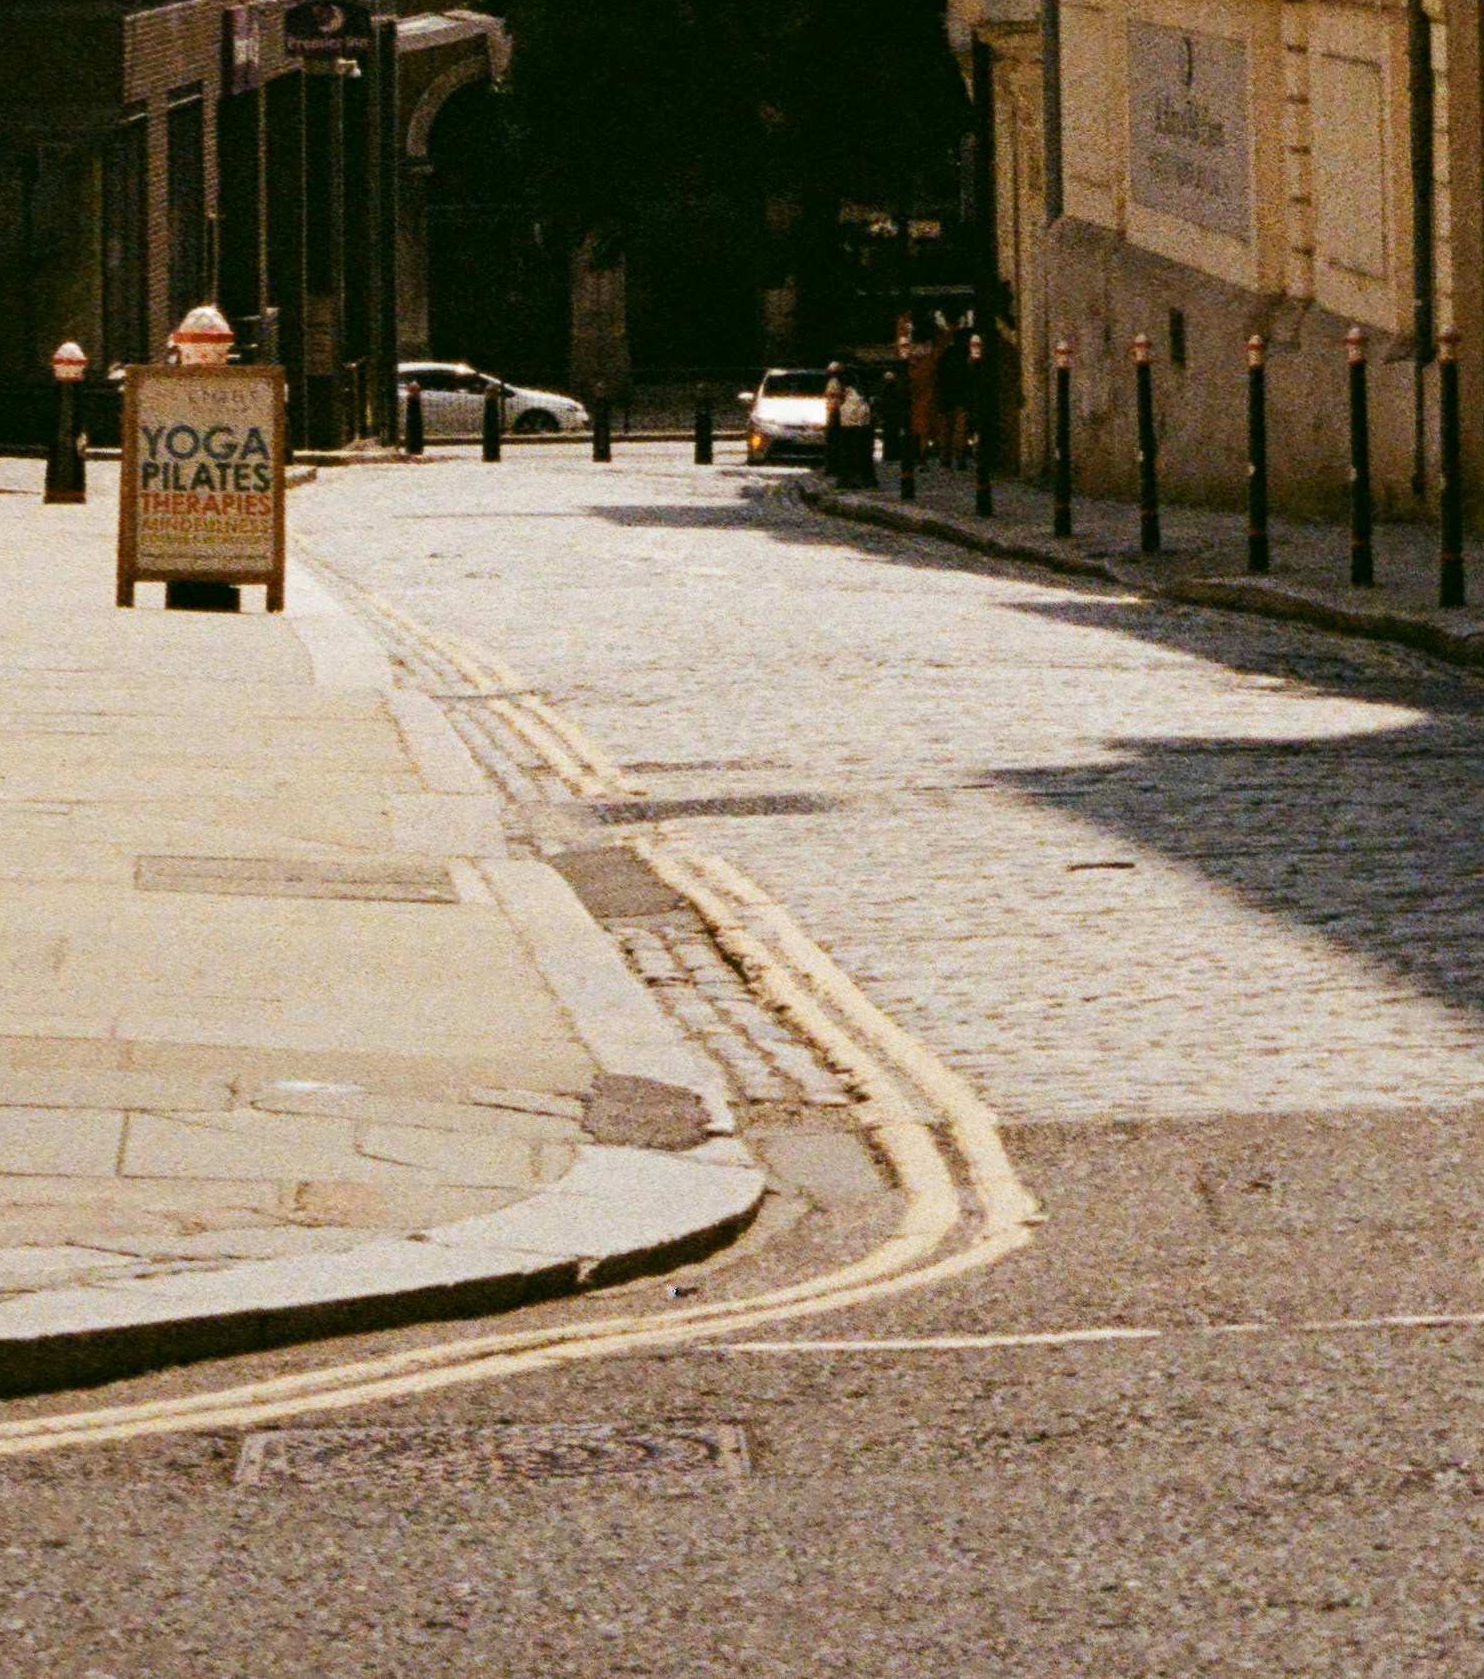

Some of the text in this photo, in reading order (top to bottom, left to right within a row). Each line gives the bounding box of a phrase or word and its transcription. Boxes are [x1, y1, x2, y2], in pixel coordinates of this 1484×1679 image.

[141, 424, 269, 461] YOGA
[141, 462, 271, 492] PILATES
[141, 493, 272, 515] THERAPIES
